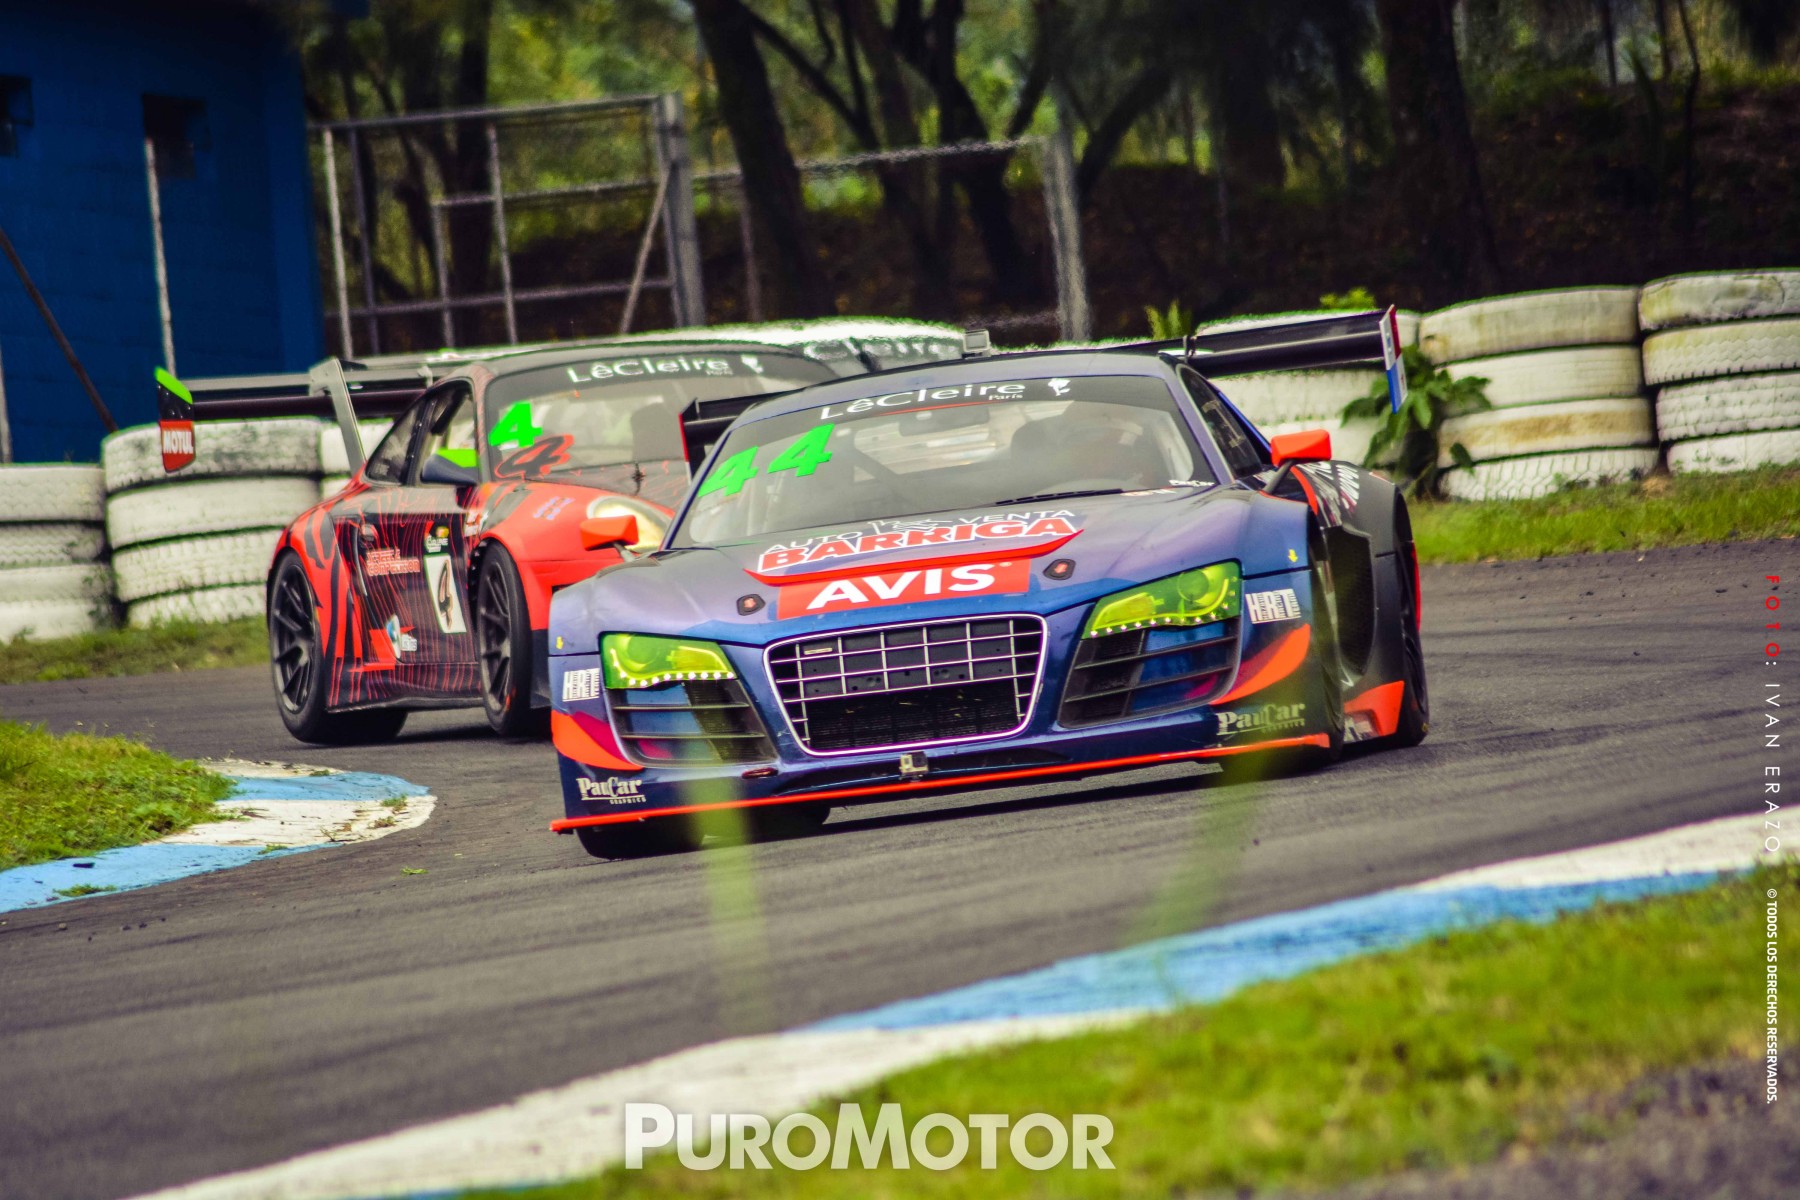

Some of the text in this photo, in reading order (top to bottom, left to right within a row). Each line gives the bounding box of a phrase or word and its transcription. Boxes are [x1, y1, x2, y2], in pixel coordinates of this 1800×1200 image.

[162, 430, 194, 454] MOTUL
[488, 401, 543, 448] 4
[757, 517, 1077, 573] BARRIGA
[764, 510, 1076, 554] AUTO VENTA
[806, 563, 996, 611] AVIS
